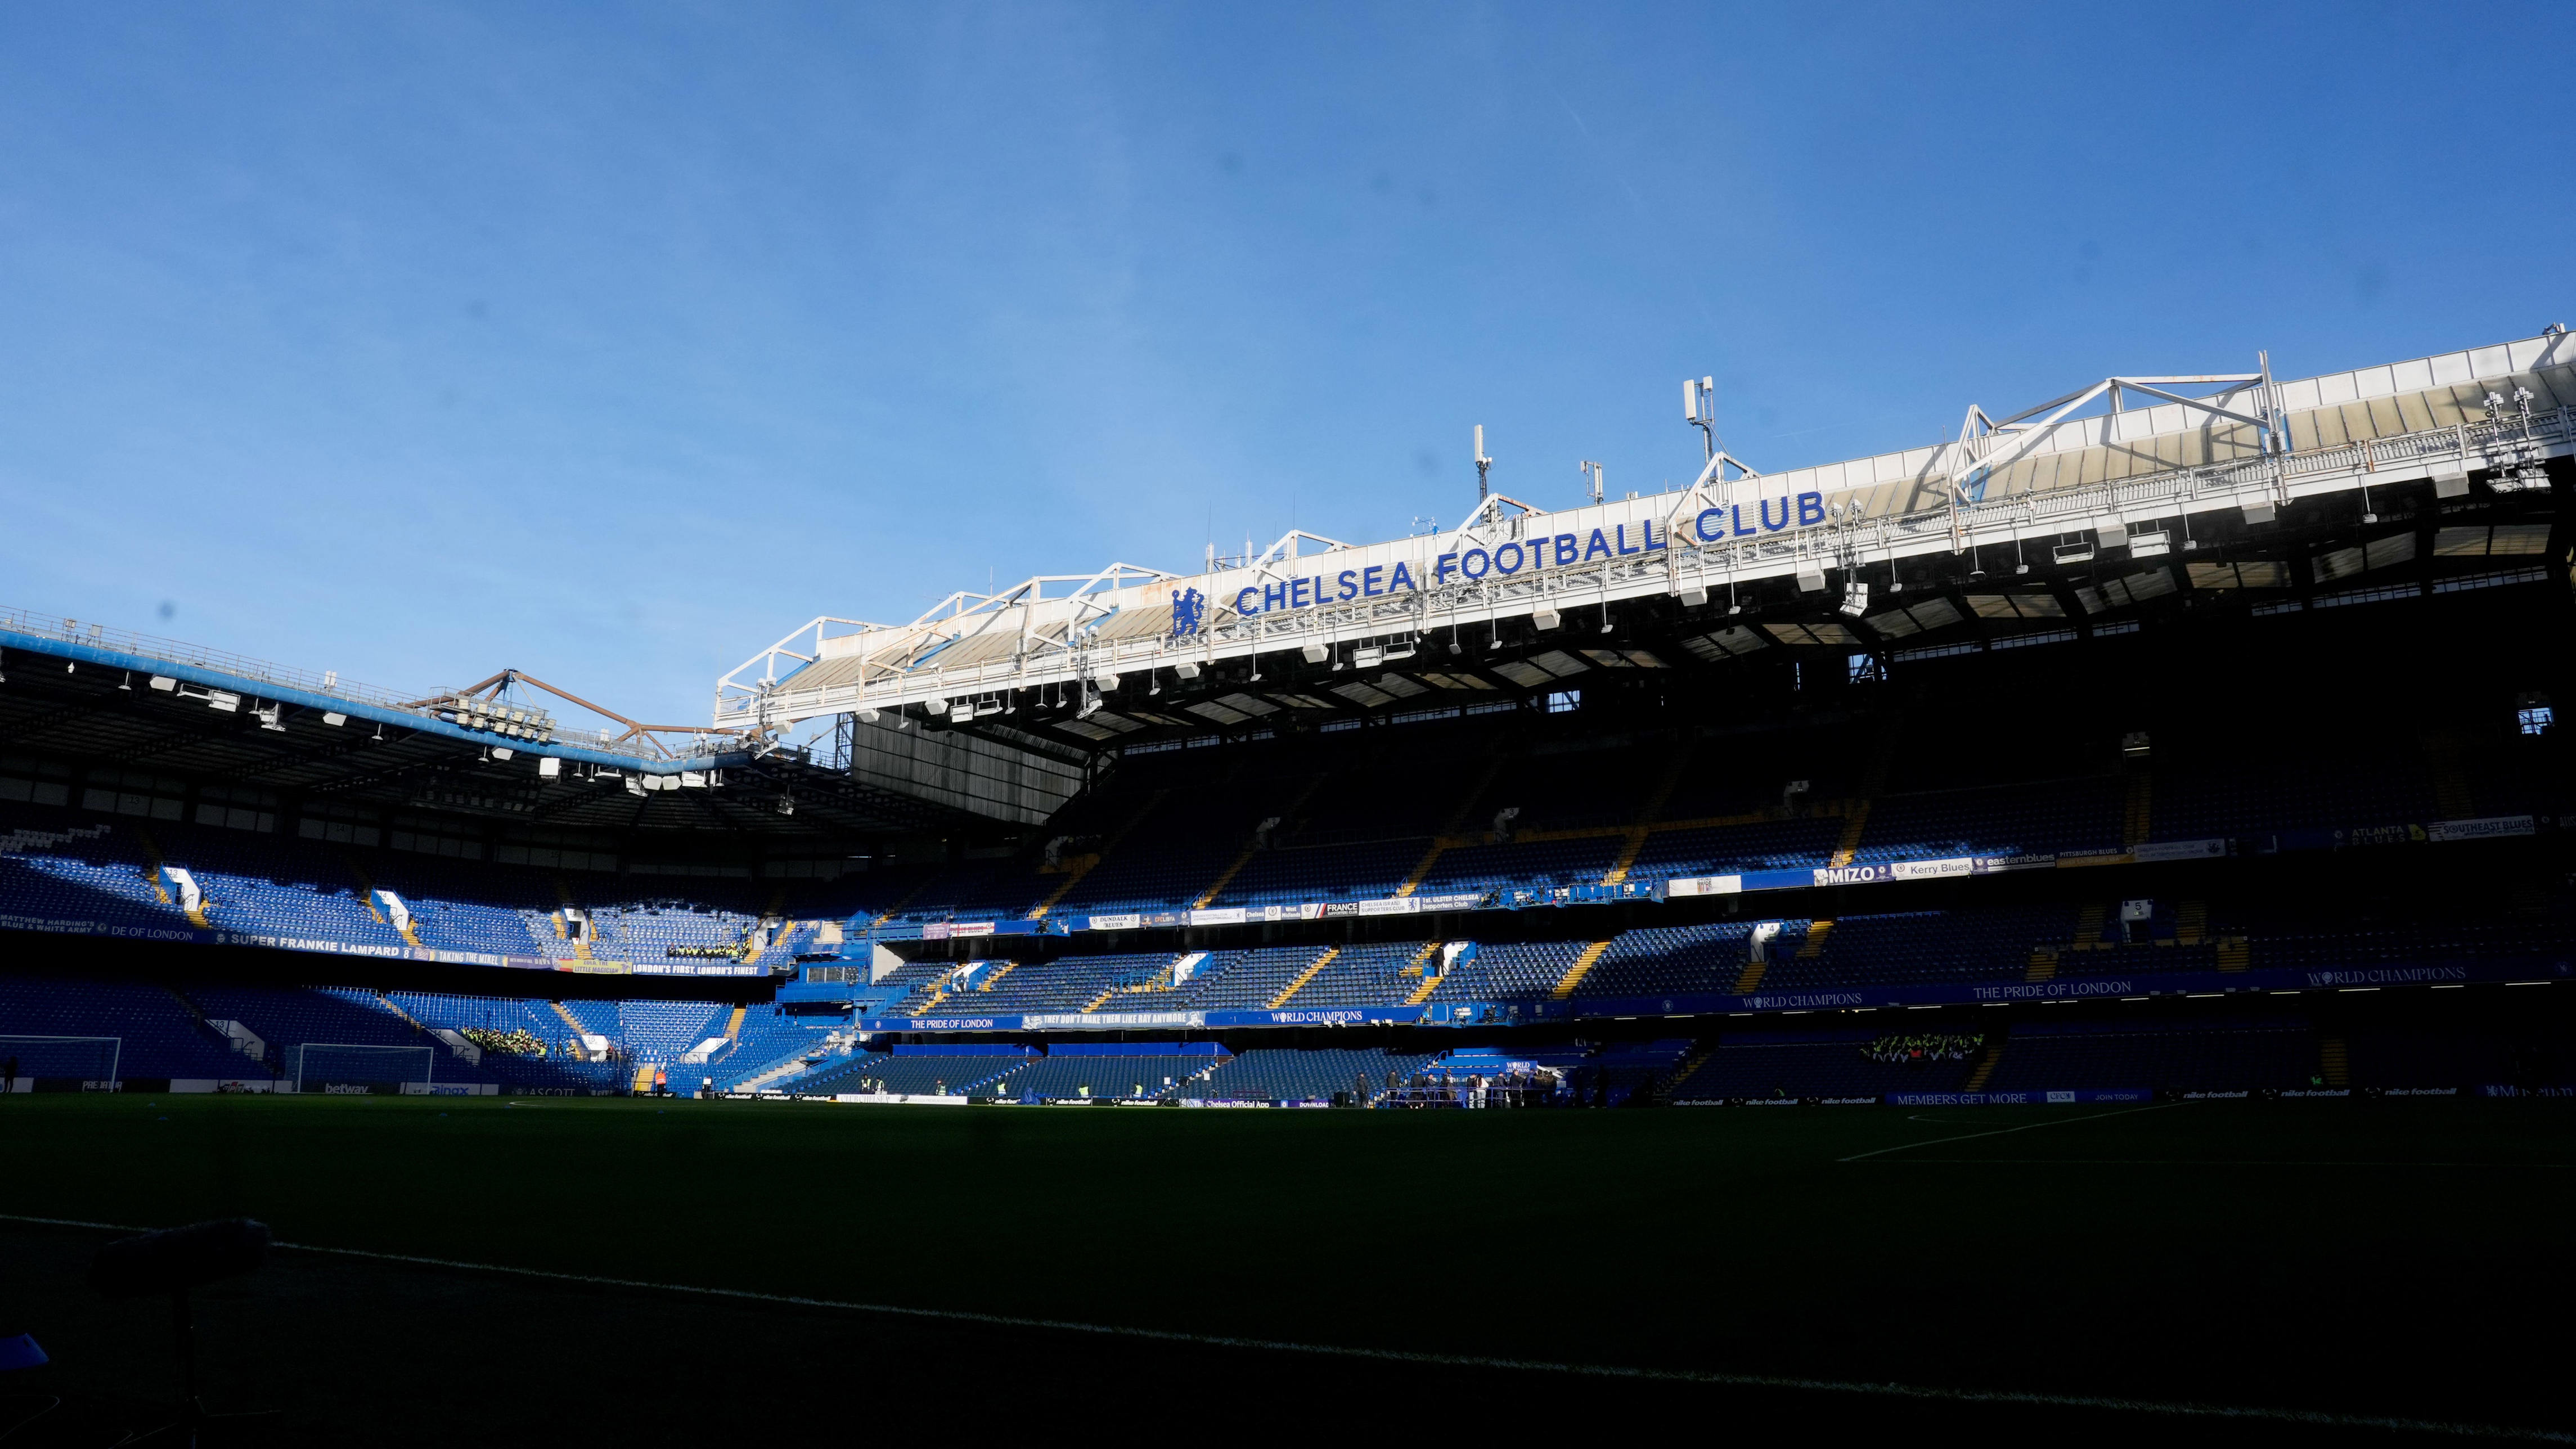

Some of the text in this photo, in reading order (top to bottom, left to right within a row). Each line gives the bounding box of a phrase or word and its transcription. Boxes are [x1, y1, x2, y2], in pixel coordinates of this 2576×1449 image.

[1237, 491, 1826, 616] CHELSEA FOOTBALL CLUB
[2443, 822, 2499, 834] SOUTHEAST
[2502, 819, 2532, 829] BLUES
[2560, 815, 2576, 829] AUS
[2352, 826, 2403, 837] ATLANTA
[1987, 853, 2054, 866] easternblues
[1828, 867, 1874, 884] MIZO
[1327, 903, 1357, 912] FRANCE
[0, 915, 44, 924] MATTHEW
[113, 926, 193, 940] DE OF LONDON
[231, 934, 410, 958] SUPER FRANKIE LAMPARD 8
[439, 952, 464, 961] TAKING
[466, 952, 477, 962] THE
[479, 954, 498, 965] MIKEL
[633, 963, 758, 975] LONDON'S FIRST, LONDON'S FINEST
[2308, 967, 2466, 984] WORLD CHAMPIONS
[1974, 981, 2131, 998] THE PRIDE OF LONDON
[1743, 993, 1862, 1008] WORLD CHAMPIONS
[1044, 1013, 1186, 1024] THEY DON'T MAKE THEM LIKE RAY ANYMORE
[1271, 1011, 1362, 1023] WORLD CHAMPIONS
[911, 1019, 993, 1029] THE PRIDE OF LONDON
[82, 1081, 123, 1092] PREATR
[325, 1083, 369, 1094] betway
[1898, 1094, 2027, 1105] MEMBERS GET MORE
